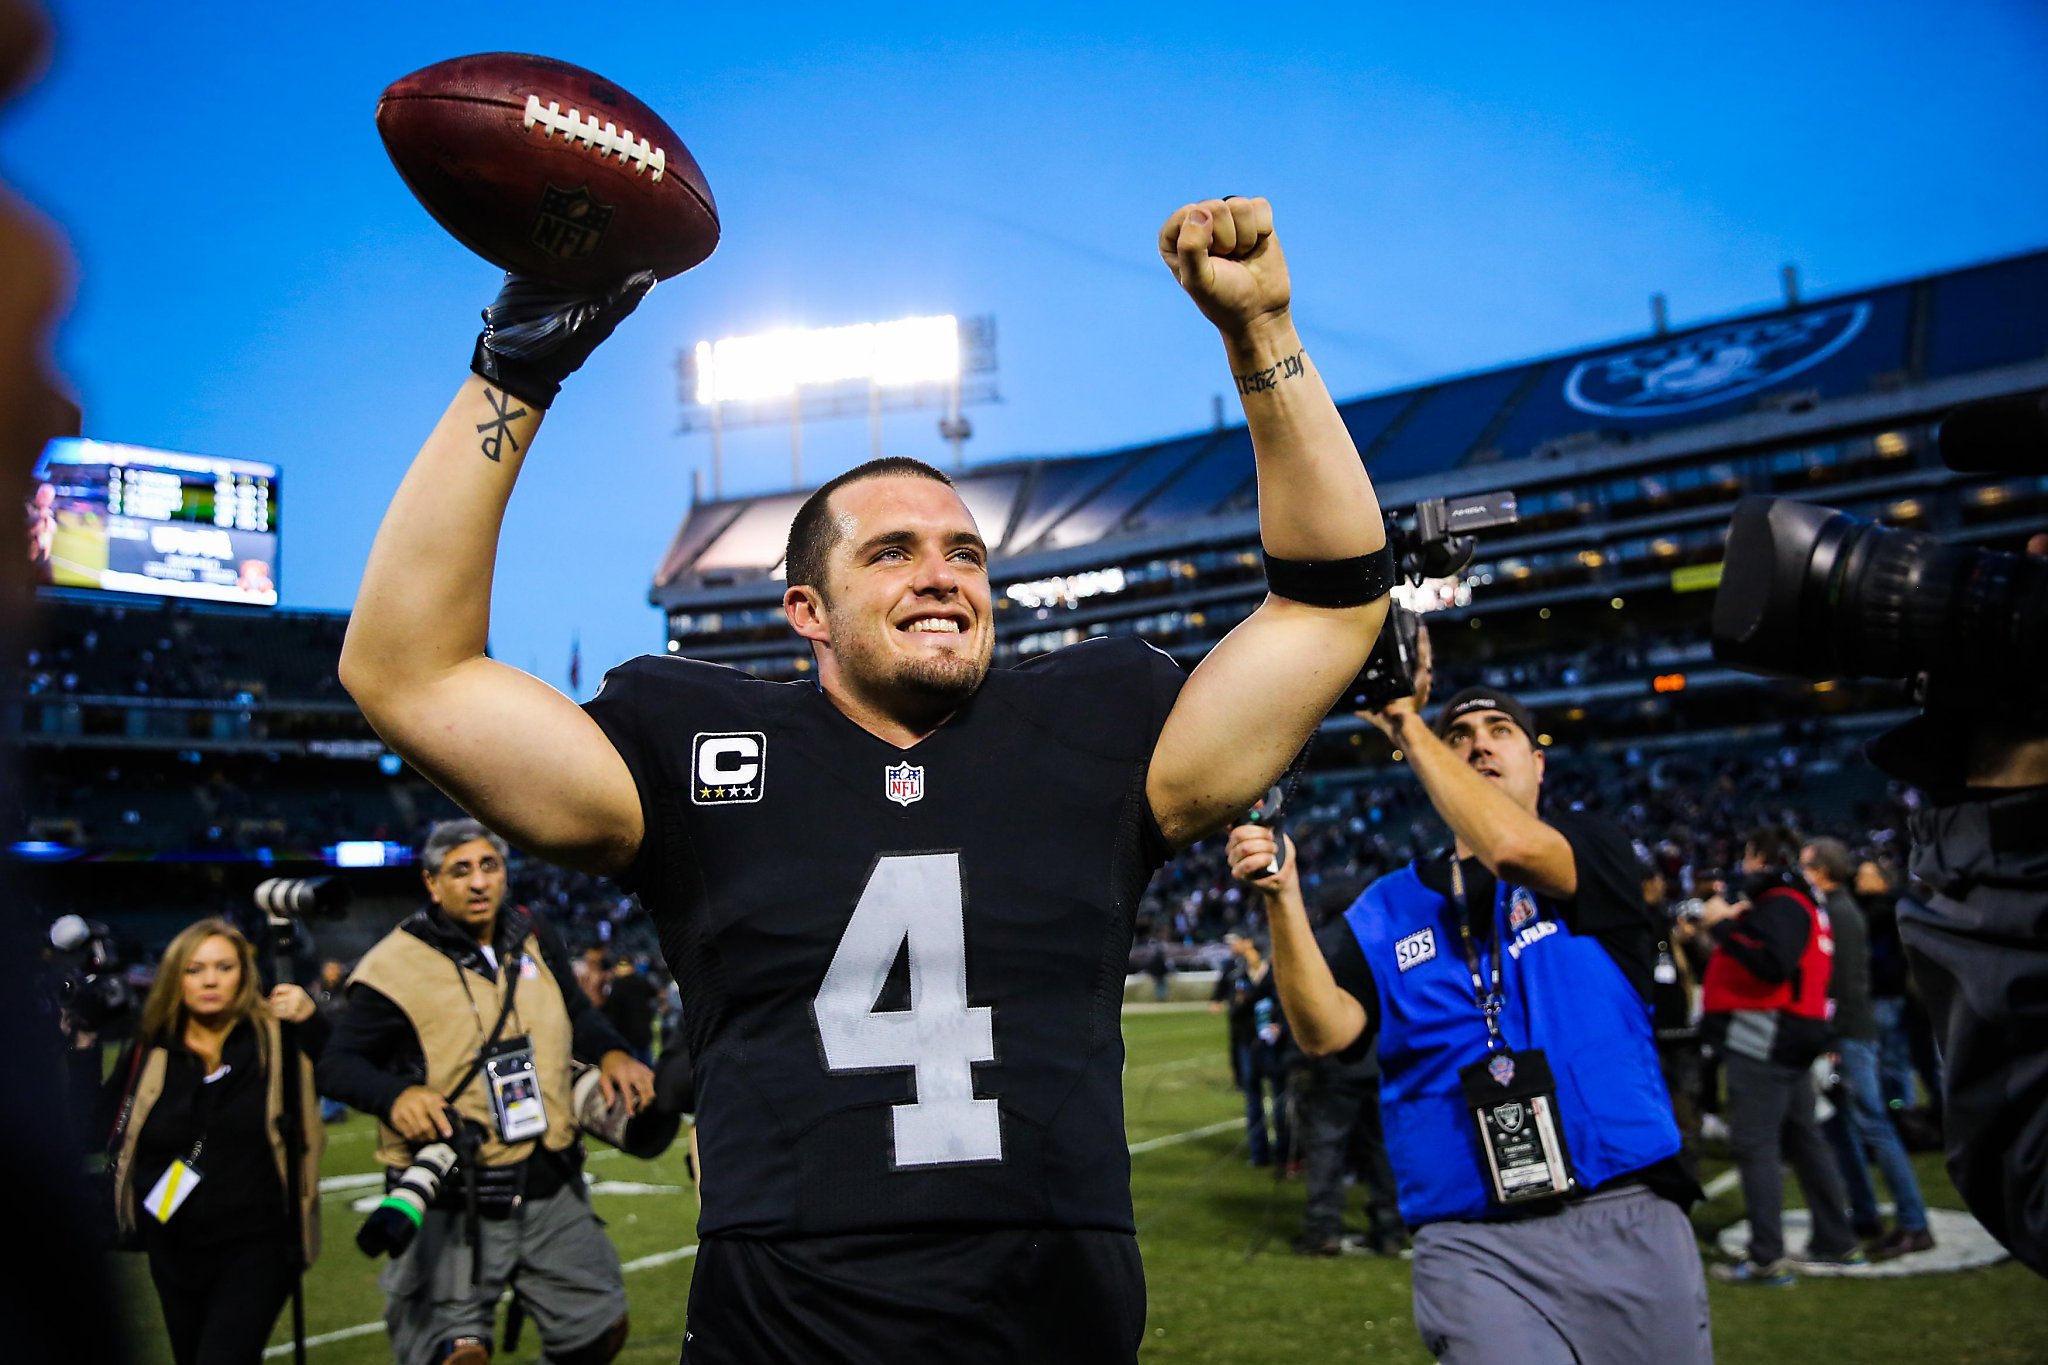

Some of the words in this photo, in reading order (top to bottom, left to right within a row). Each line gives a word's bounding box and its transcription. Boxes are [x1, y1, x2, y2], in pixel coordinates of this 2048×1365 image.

[533, 214, 602, 258] NFL
[698, 736, 759, 786] C
[891, 780, 918, 798] NFL
[1399, 933, 1432, 964] SDS
[813, 852, 1003, 1167] 4
